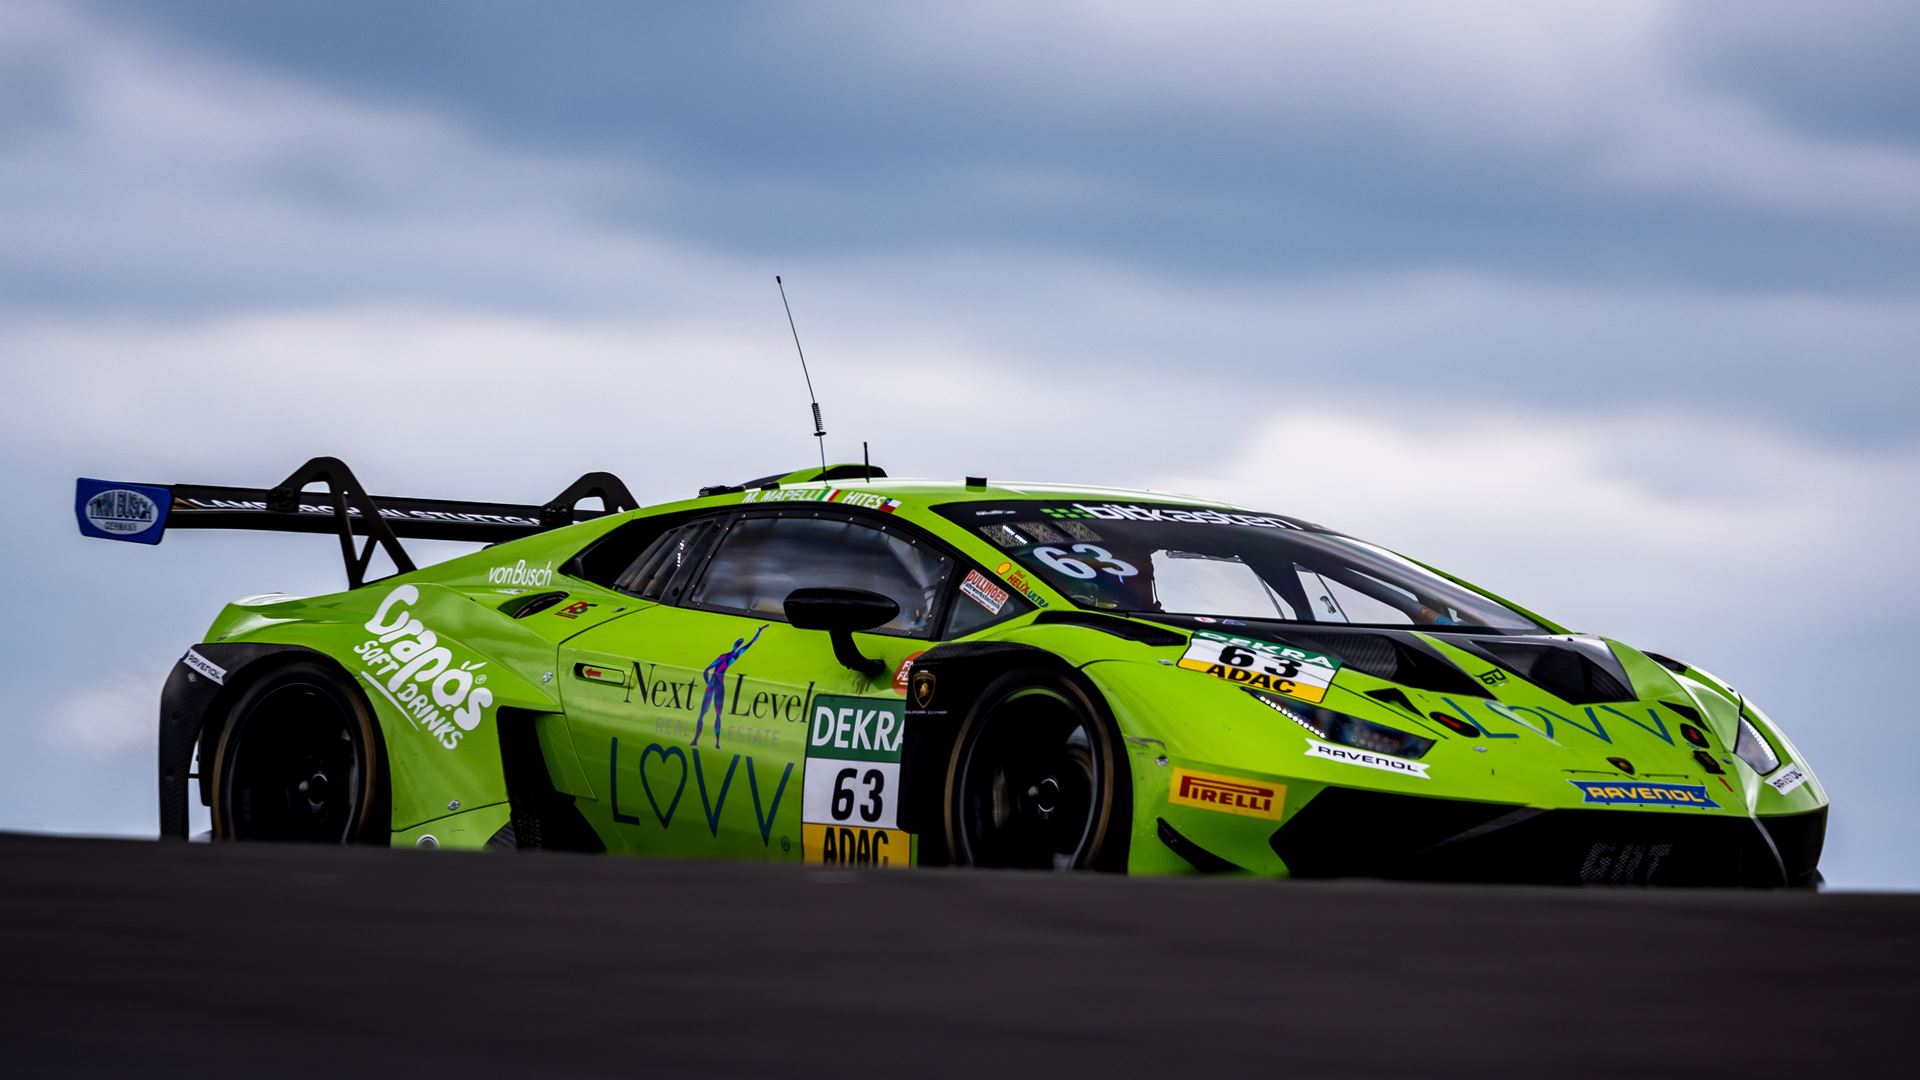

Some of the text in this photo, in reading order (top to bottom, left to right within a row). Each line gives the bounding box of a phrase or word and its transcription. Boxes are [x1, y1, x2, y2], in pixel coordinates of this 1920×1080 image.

[116, 490, 153, 520] BUSCH
[742, 489, 823, 504] M. MAPELLI
[842, 491, 886, 509] HITES
[1072, 503, 1304, 531] bitkasten
[488, 559, 553, 586] vonBusch
[1033, 543, 1139, 581] 63
[967, 570, 1007, 604] DULLINGER
[1200, 631, 1334, 670] DEKRA
[1218, 645, 1303, 679] 63
[354, 640, 464, 750] SOFT DRINKS
[624, 661, 815, 724] Next Level
[1206, 664, 1297, 694] ADAC
[655, 716, 780, 747] REAL ESTATE
[1317, 745, 1419, 773] RAVENOL
[831, 767, 885, 823] 63
[1179, 775, 1275, 812] PIRELLI
[1586, 785, 1705, 803] RAVENOL
[823, 827, 889, 866] ADAC
